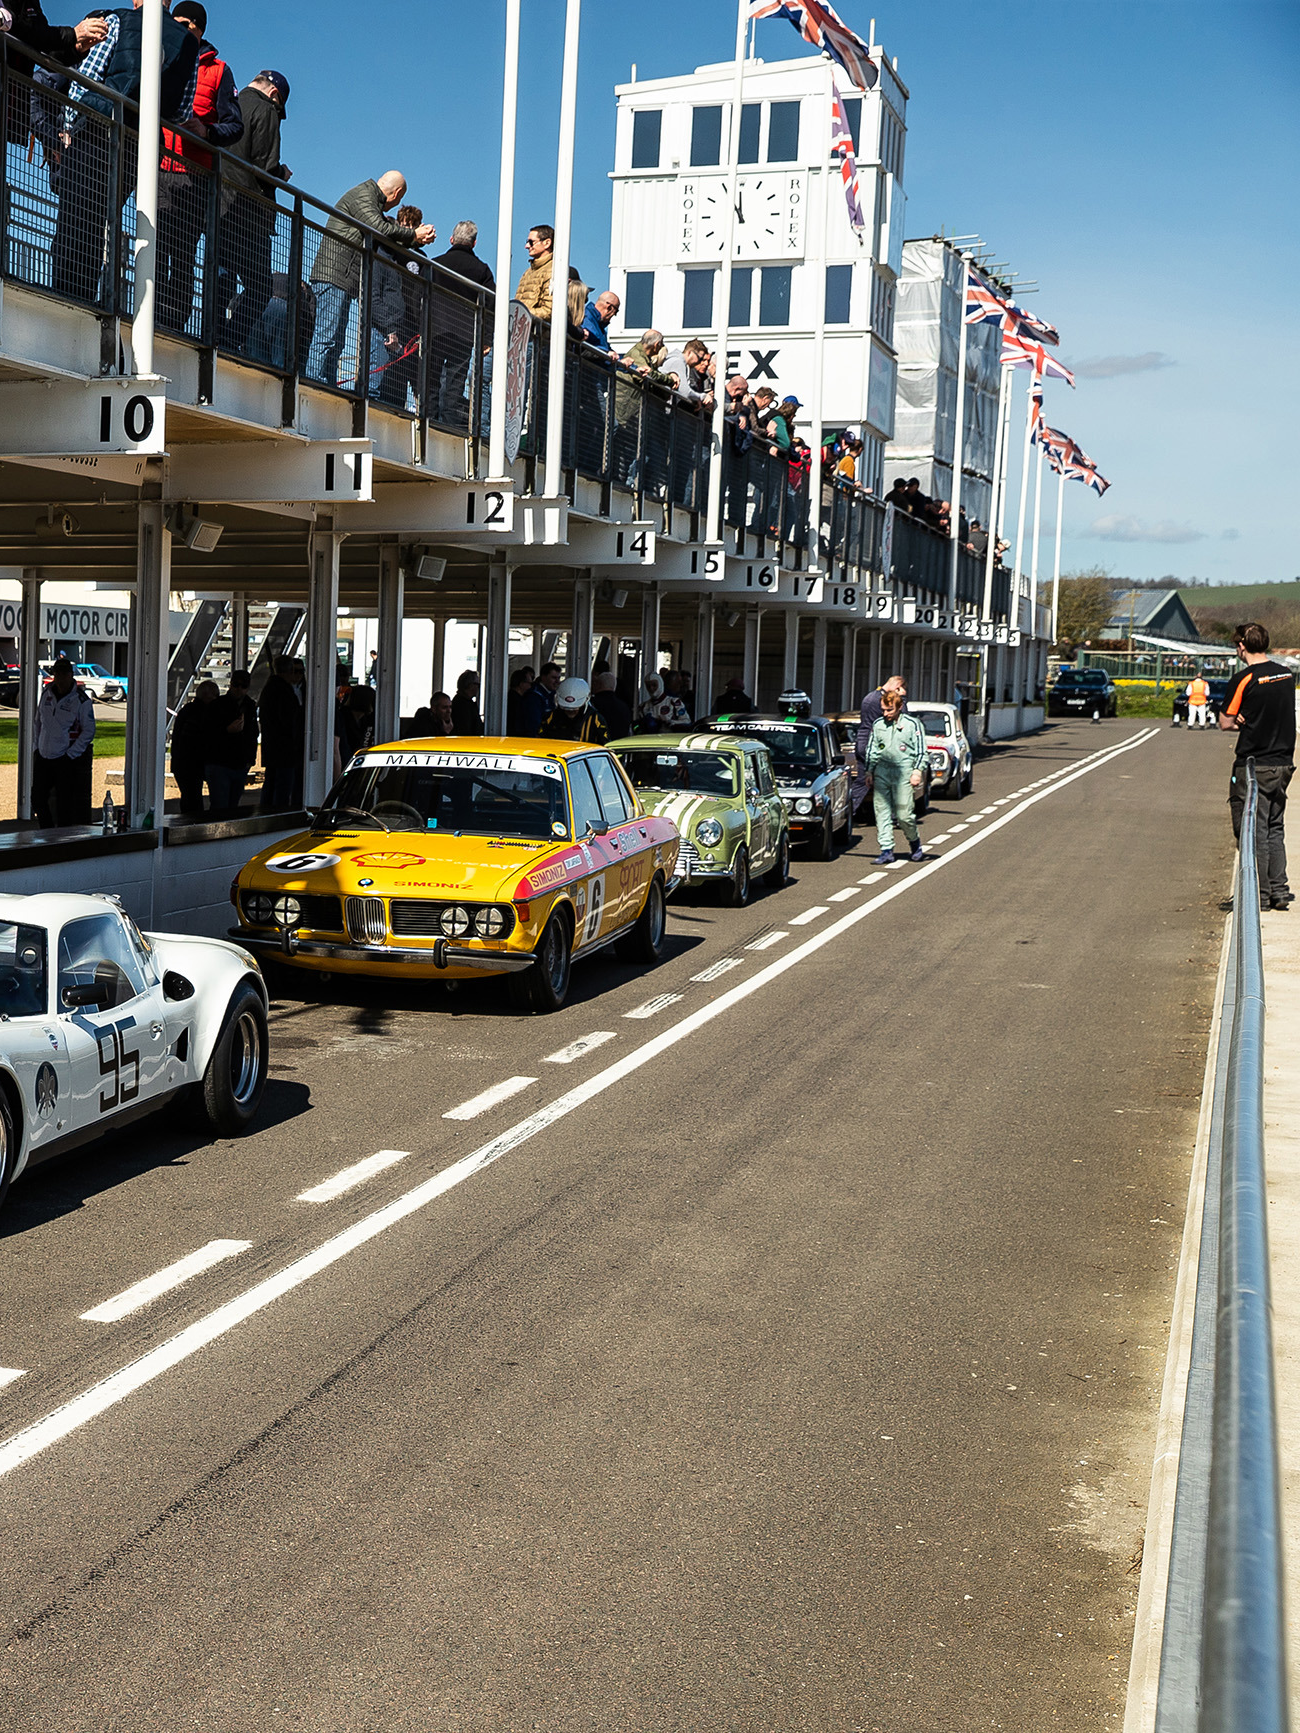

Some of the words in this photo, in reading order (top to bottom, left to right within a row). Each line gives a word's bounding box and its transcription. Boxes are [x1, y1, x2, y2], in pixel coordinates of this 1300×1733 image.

[681, 184, 694, 253] ROLEX
[787, 179, 801, 248] ROLEX
[100, 394, 154, 443] 10
[325, 453, 362, 491] 11
[467, 492, 505, 524] 12
[616, 531, 648, 557] 14
[690, 551, 719, 574] 15
[746, 565, 773, 587] 16
[793, 577, 818, 596] 17
[832, 587, 856, 605] 18
[866, 596, 888, 612] 19
[46, 608, 100, 635] MOTOR
[915, 609, 935, 623] 20
[938, 615, 955, 629] 21
[958, 620, 973, 632] 22
[715, 724, 746, 732] TEAM
[747, 724, 798, 733] CASTROL
[385, 754, 517, 771] MATHWALL
[617, 826, 641, 853] Shell
[276, 853, 328, 870] 6
[393, 880, 475, 890] SIMONIZ
[529, 864, 565, 888] SIMONIZ
[587, 879, 601, 940] 6
[93, 1015, 140, 1113] 95
